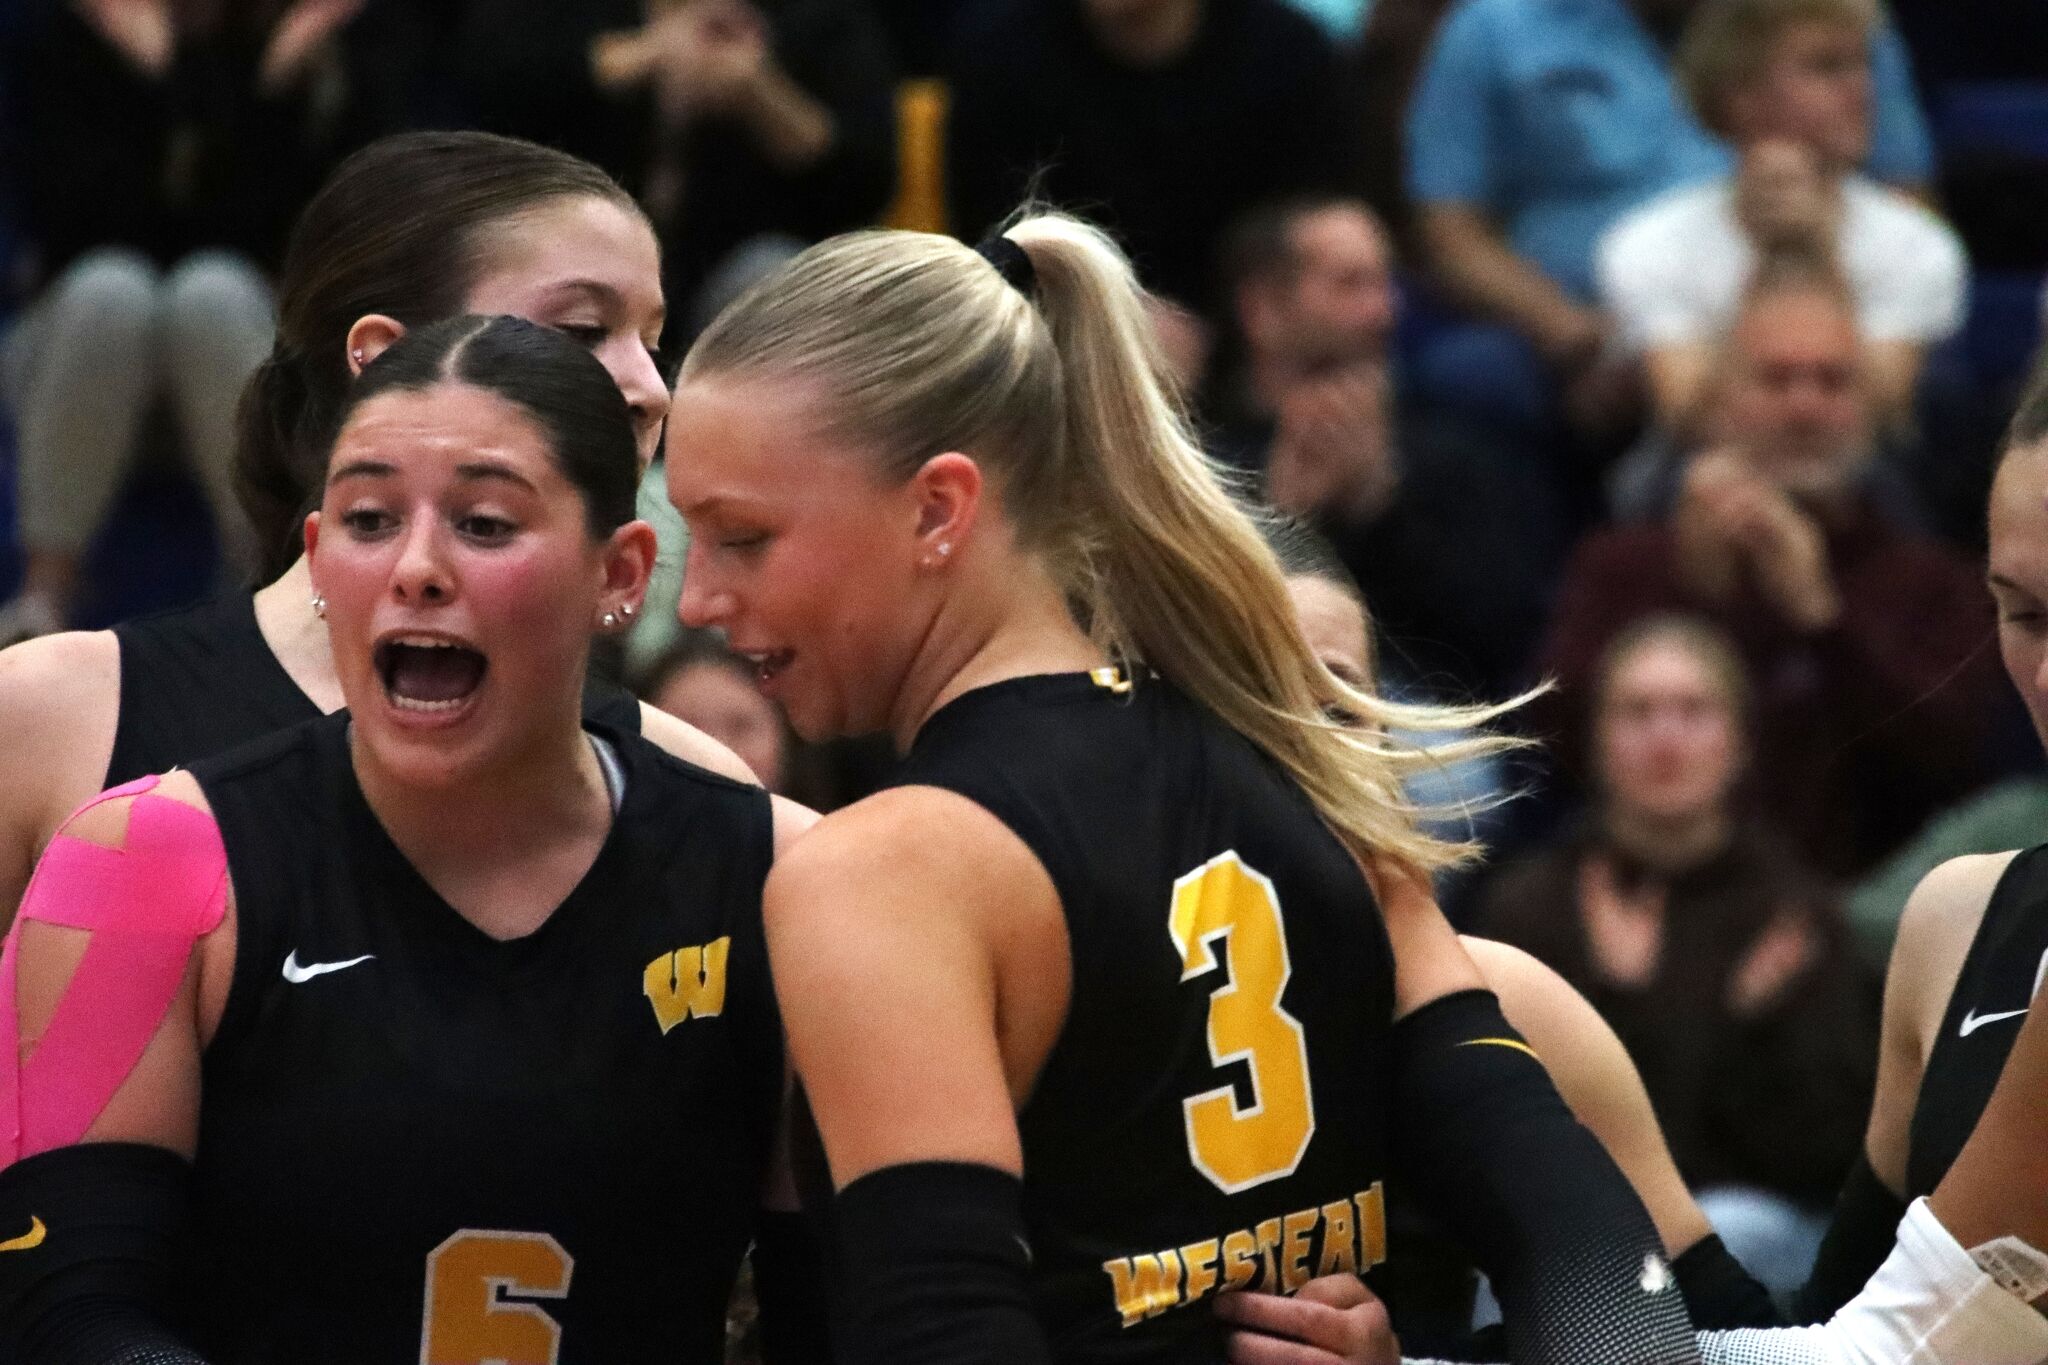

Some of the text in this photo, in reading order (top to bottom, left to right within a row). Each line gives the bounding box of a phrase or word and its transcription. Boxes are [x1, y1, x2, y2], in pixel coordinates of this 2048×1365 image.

[643, 935, 732, 1036] W
[1168, 849, 1316, 1195] 3
[419, 1228, 575, 1365] 6
